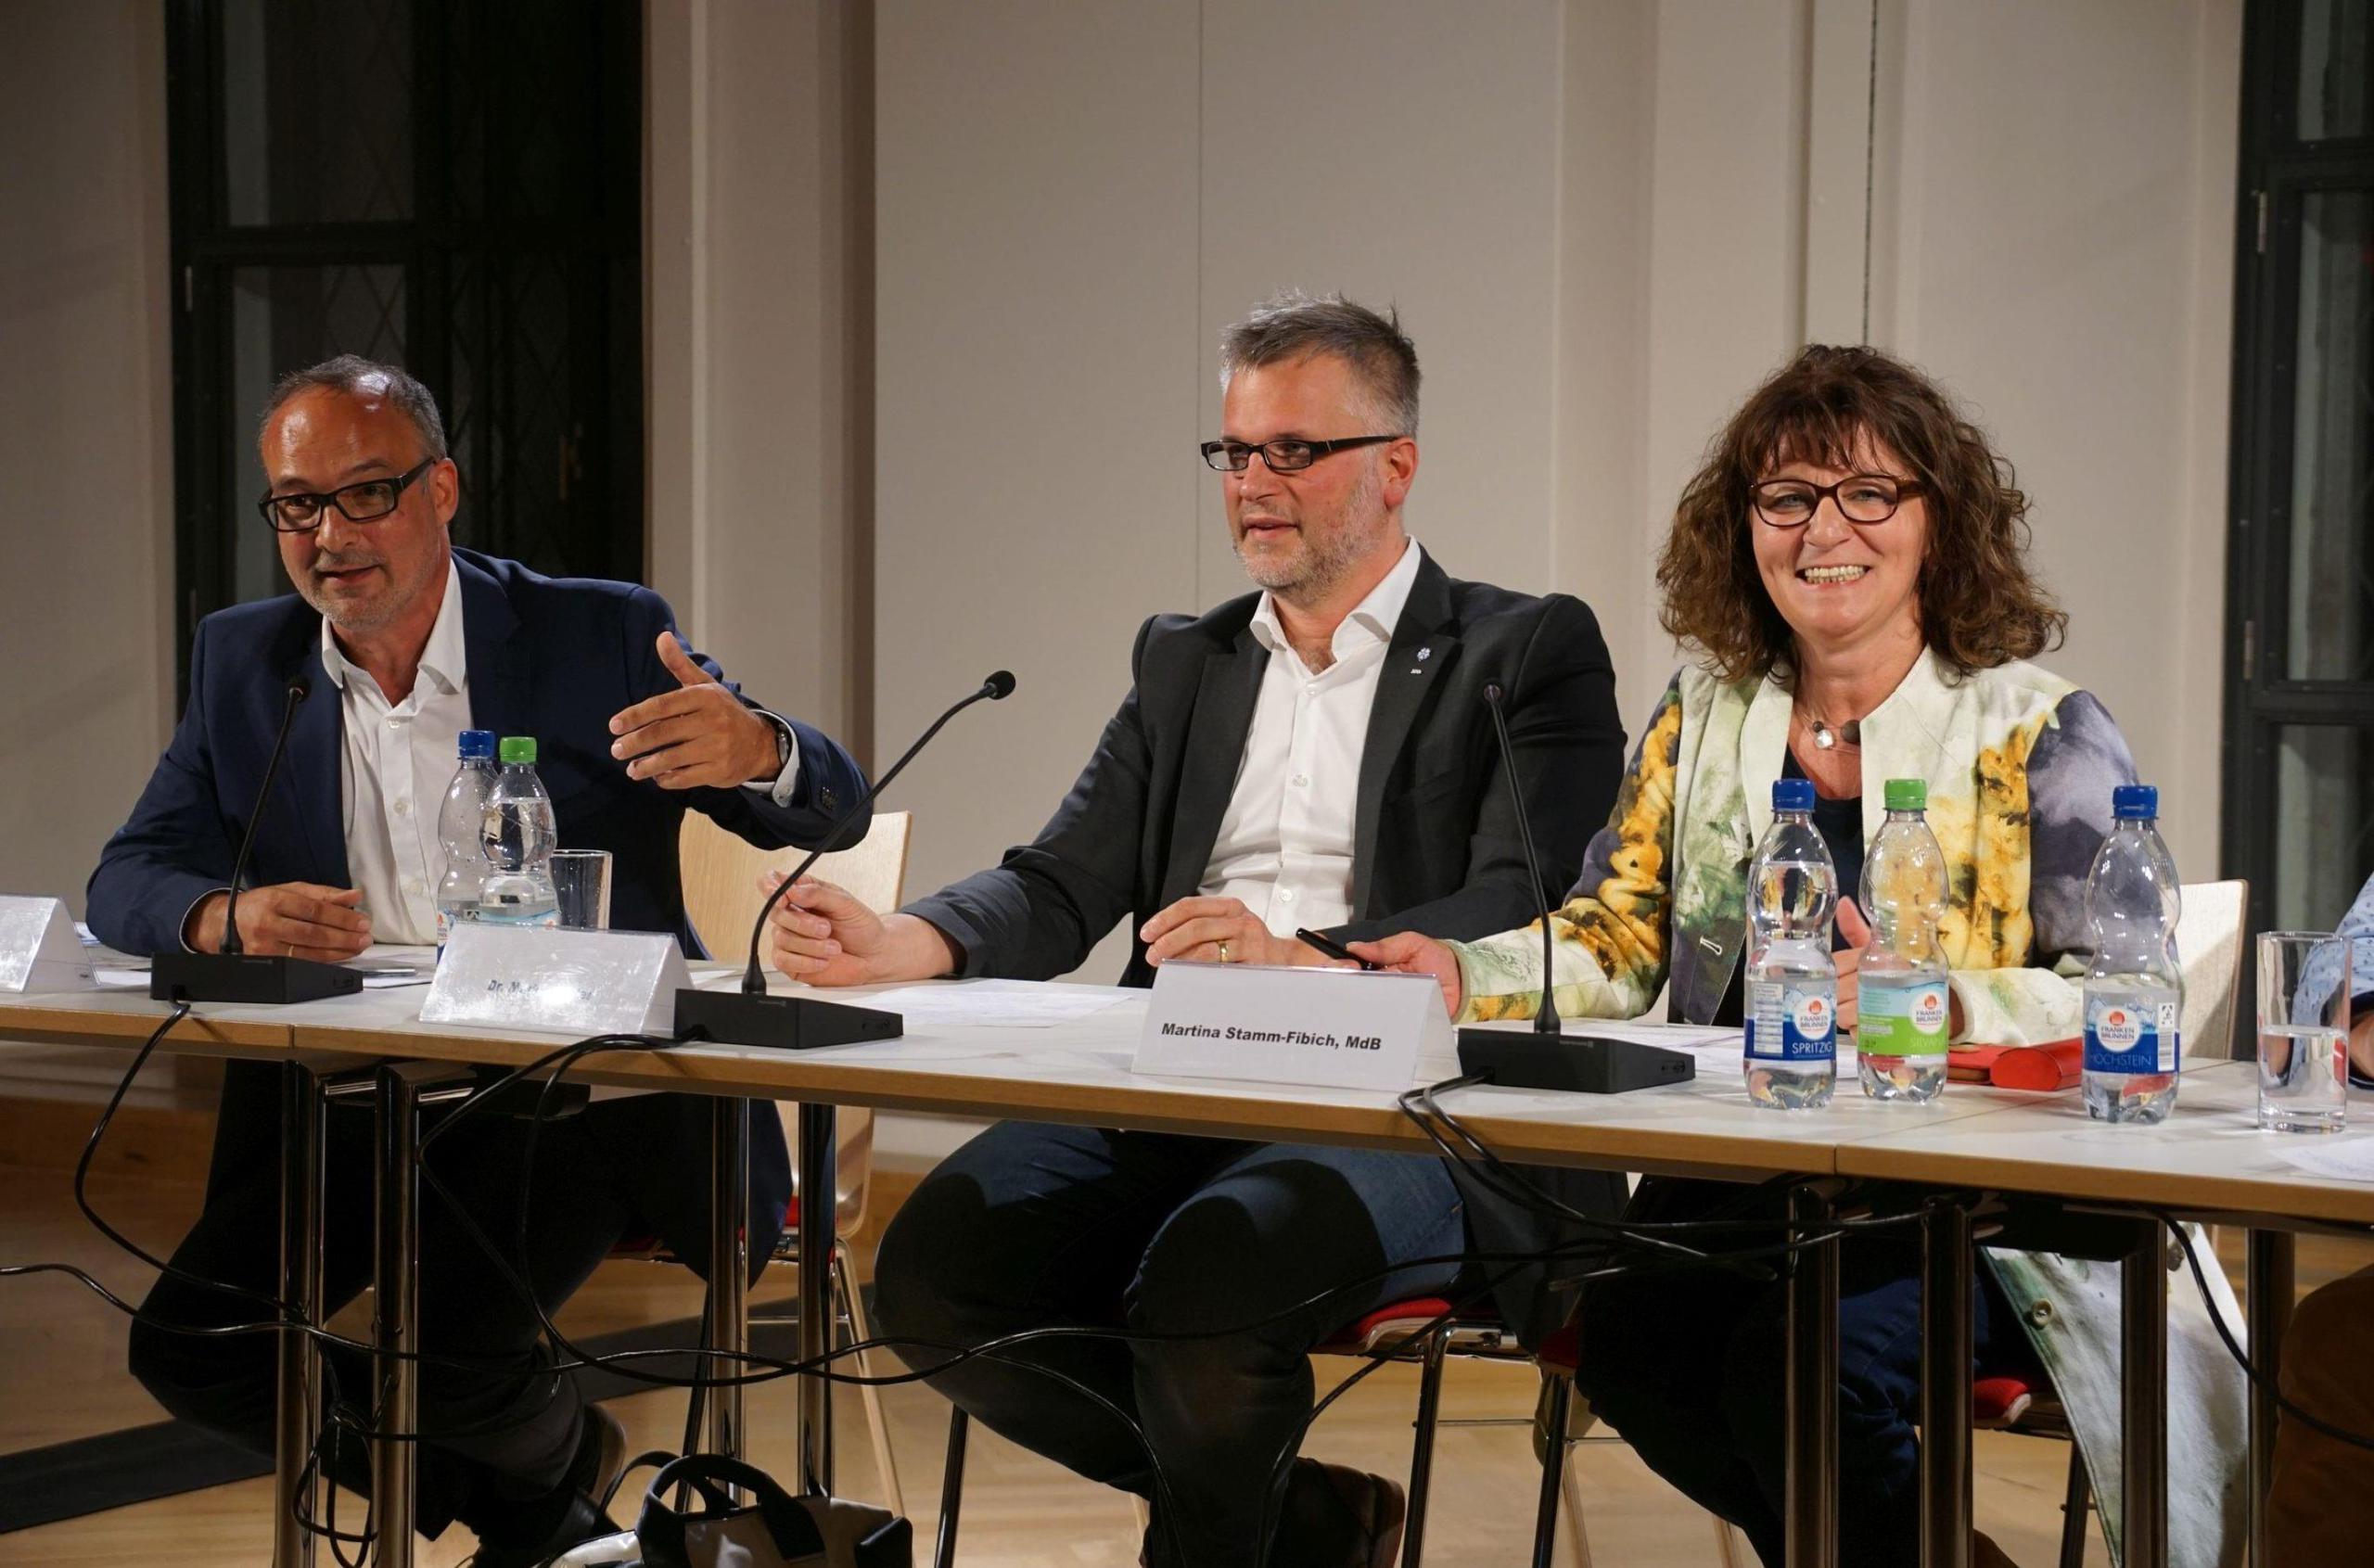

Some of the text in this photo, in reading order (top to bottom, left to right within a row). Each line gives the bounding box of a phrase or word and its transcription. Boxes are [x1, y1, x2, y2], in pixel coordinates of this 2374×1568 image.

[487, 979, 504, 992] Dr.
[1161, 1023, 1382, 1051] Martina Stamm-Fibich, MdB
[1792, 1041, 1832, 1054] SPRITZIG
